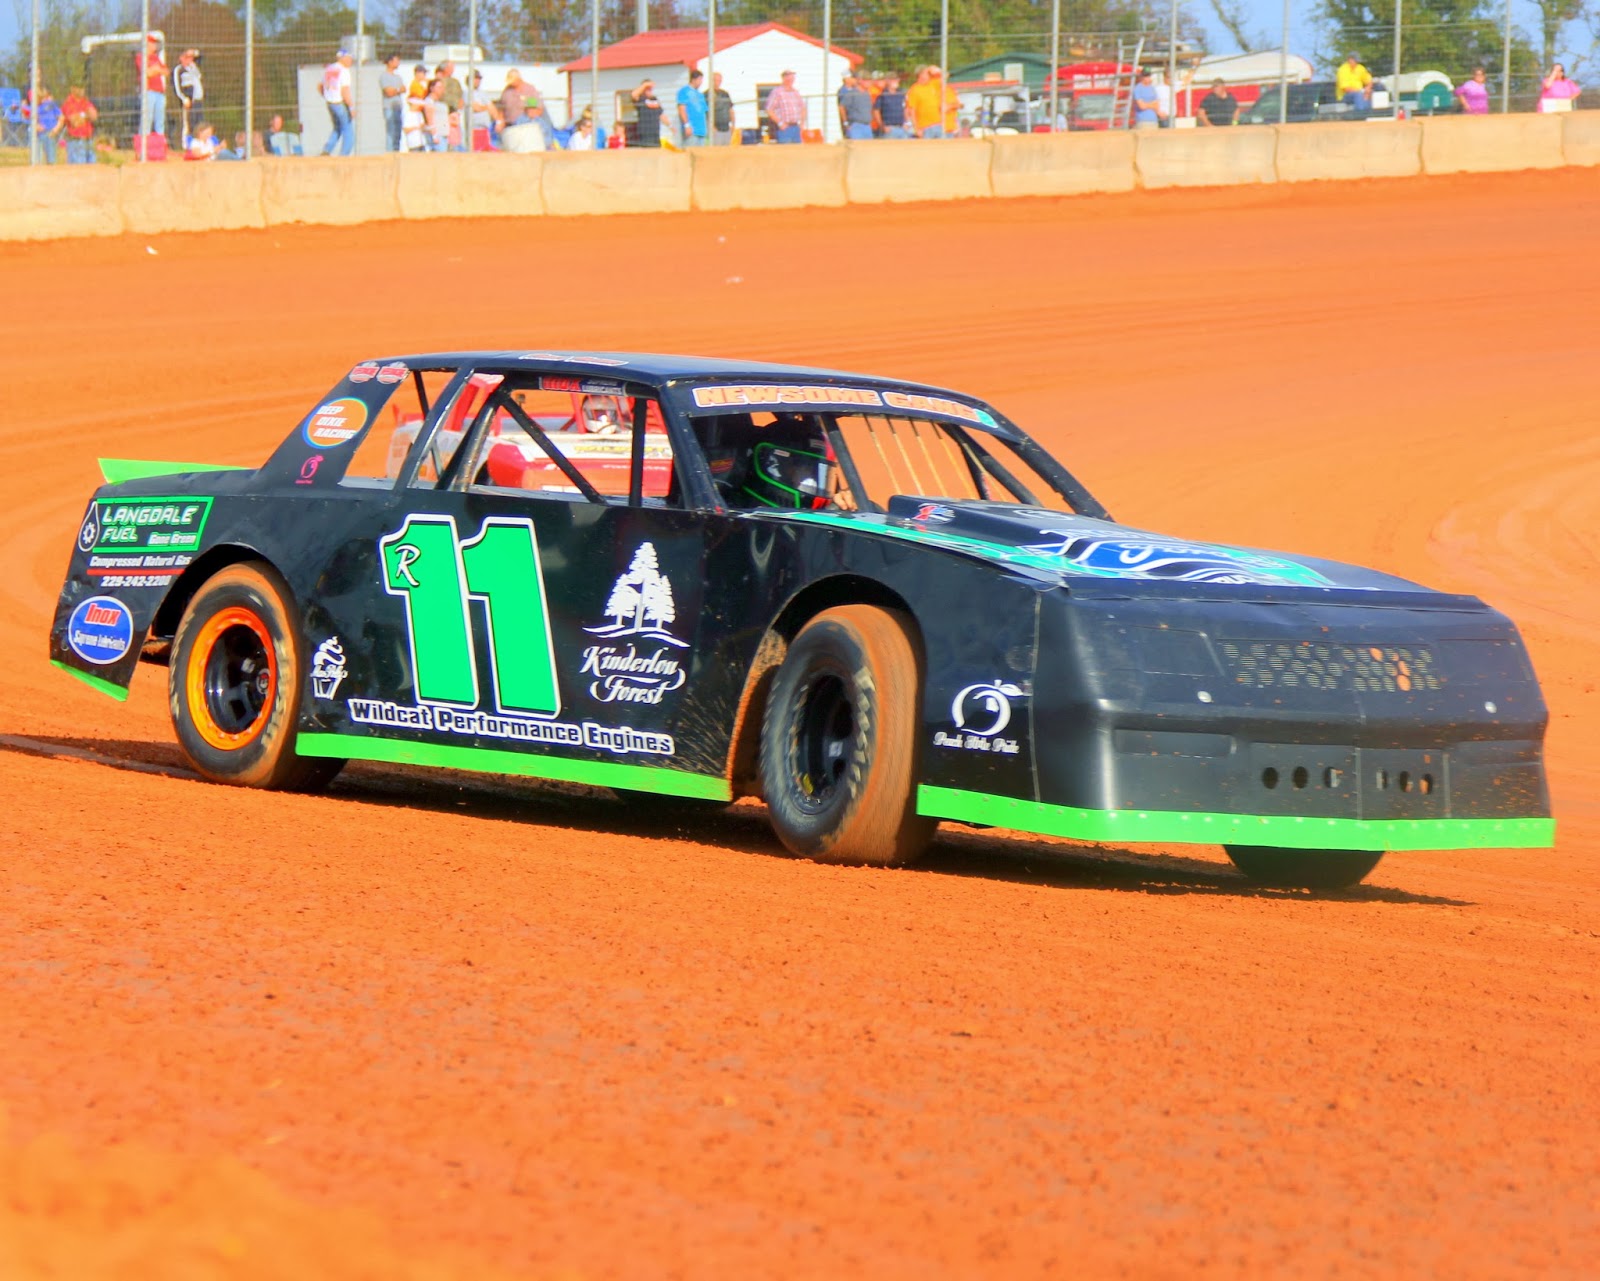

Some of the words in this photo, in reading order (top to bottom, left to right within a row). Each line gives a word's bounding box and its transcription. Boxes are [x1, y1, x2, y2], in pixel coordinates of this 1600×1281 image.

[694, 387, 882, 406] NEWSOME
[103, 506, 198, 525] LANGDALE
[101, 527, 138, 542] FUEL
[90, 556, 143, 568] Compressed
[143, 556, 175, 566] Natural
[175, 555, 192, 565] Gas
[395, 544, 421, 586] R
[84, 603, 121, 626] Inox
[380, 513, 561, 719] 11
[580, 643, 680, 677] Kinderlou
[590, 675, 684, 704] Forest
[350, 699, 432, 730] Wildcat
[437, 708, 581, 745] Performance
[585, 724, 674, 754] Engines
